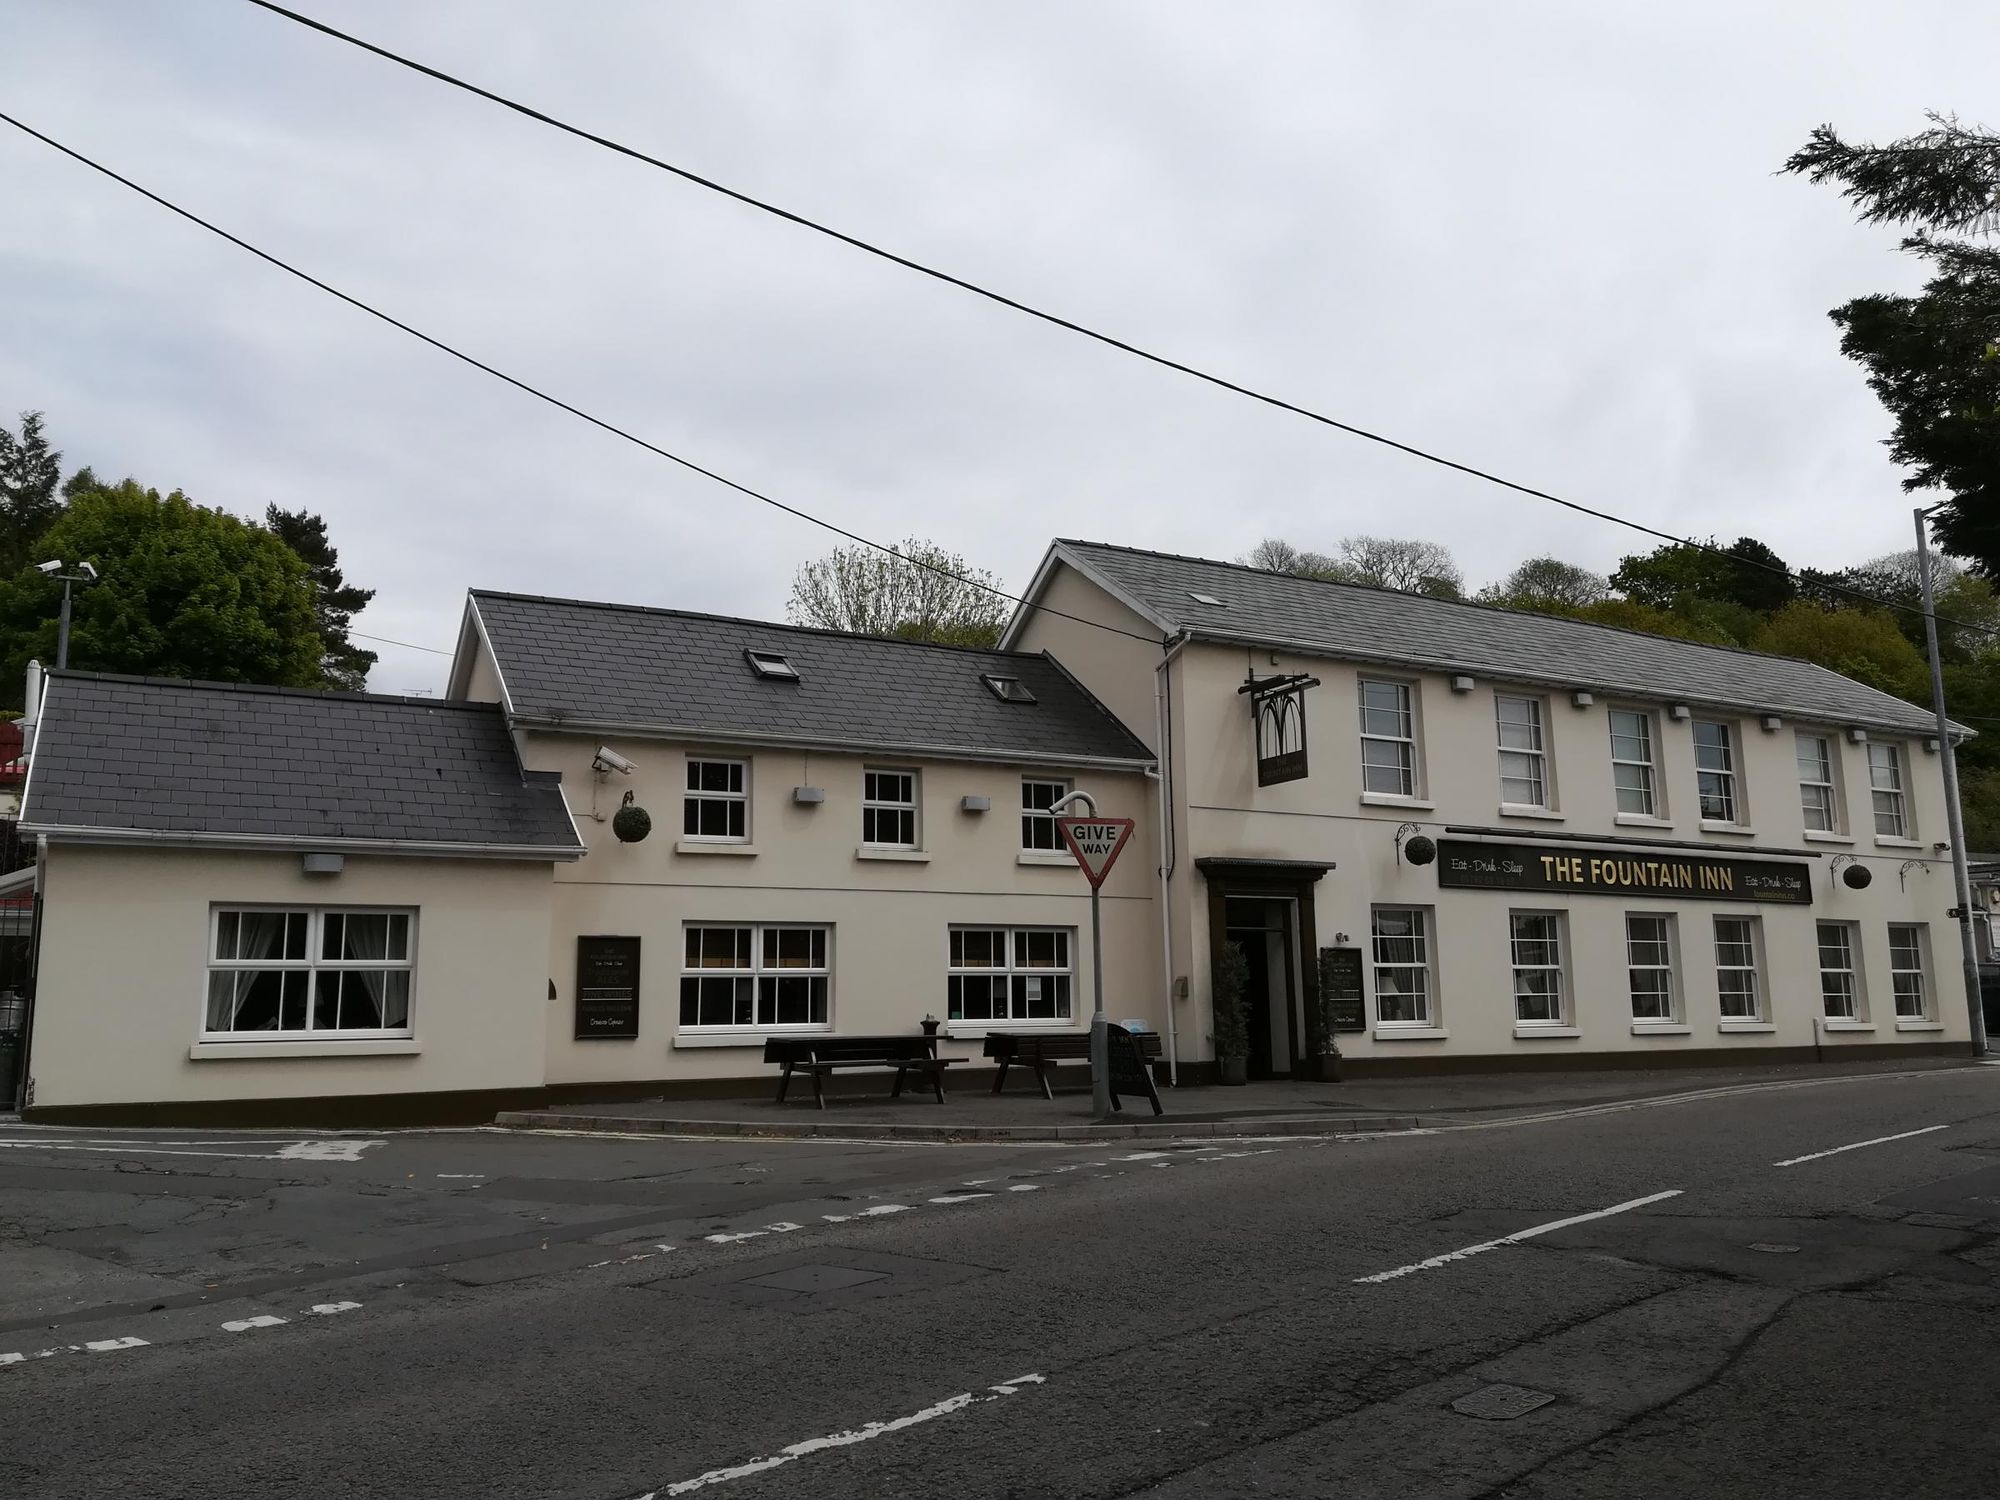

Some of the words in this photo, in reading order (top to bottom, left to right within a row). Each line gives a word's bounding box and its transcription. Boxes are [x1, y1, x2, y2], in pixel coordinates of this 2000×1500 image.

[1073, 826, 1116, 840] GIVE
[1082, 844, 1111, 854] WAY
[1540, 856, 1585, 883] THE
[1590, 859, 1693, 889] FOUNTAIN
[1698, 865, 1734, 891] INN
